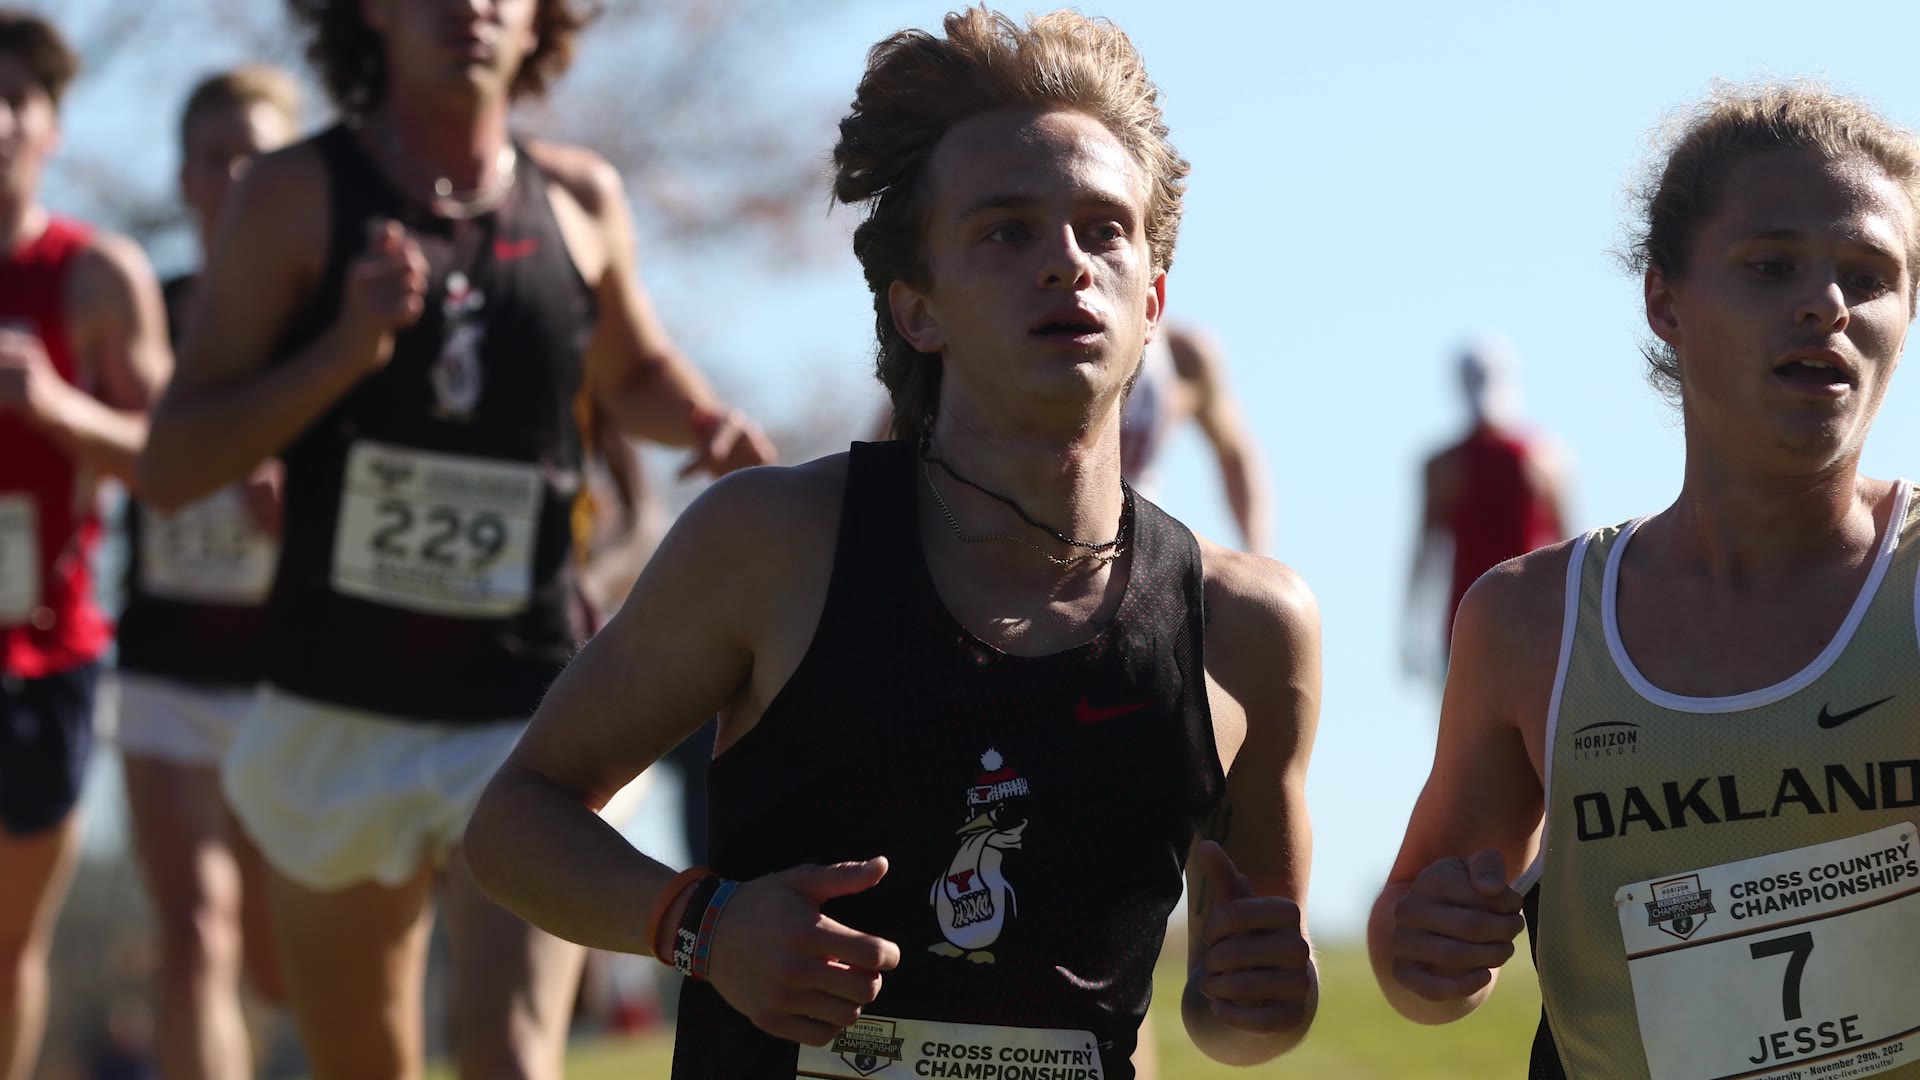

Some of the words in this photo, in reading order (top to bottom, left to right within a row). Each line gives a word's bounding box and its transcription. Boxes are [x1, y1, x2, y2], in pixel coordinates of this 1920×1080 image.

[368, 499, 508, 571] 229
[1575, 730, 1637, 750] HORIZON
[1574, 745, 1637, 761] LEAGUE
[1573, 759, 1920, 841] OAKLAND
[947, 868, 975, 894] Y
[1730, 871, 1803, 899] CROSS
[1808, 843, 1911, 882] COUNTRY
[1662, 885, 1689, 895] HORIZON
[1730, 860, 1919, 920] CHAMPIONSHIPS
[1652, 899, 1708, 918] CHAMPIONSHIP
[1749, 931, 1814, 1021] 7
[854, 1024, 883, 1033] HORIZON
[1749, 1015, 1863, 1064] JESSE
[838, 1038, 898, 1053] CHAMPIONSHIP
[921, 1042, 993, 1060] CROSS
[999, 1047, 1092, 1065] COUNTRY
[915, 1059, 1099, 1080] CHAMPIONSHIPS
[1810, 1059, 1855, 1076] November
[1856, 1051, 1881, 1064] 29th,
[1882, 1042, 1904, 1056] 2022
